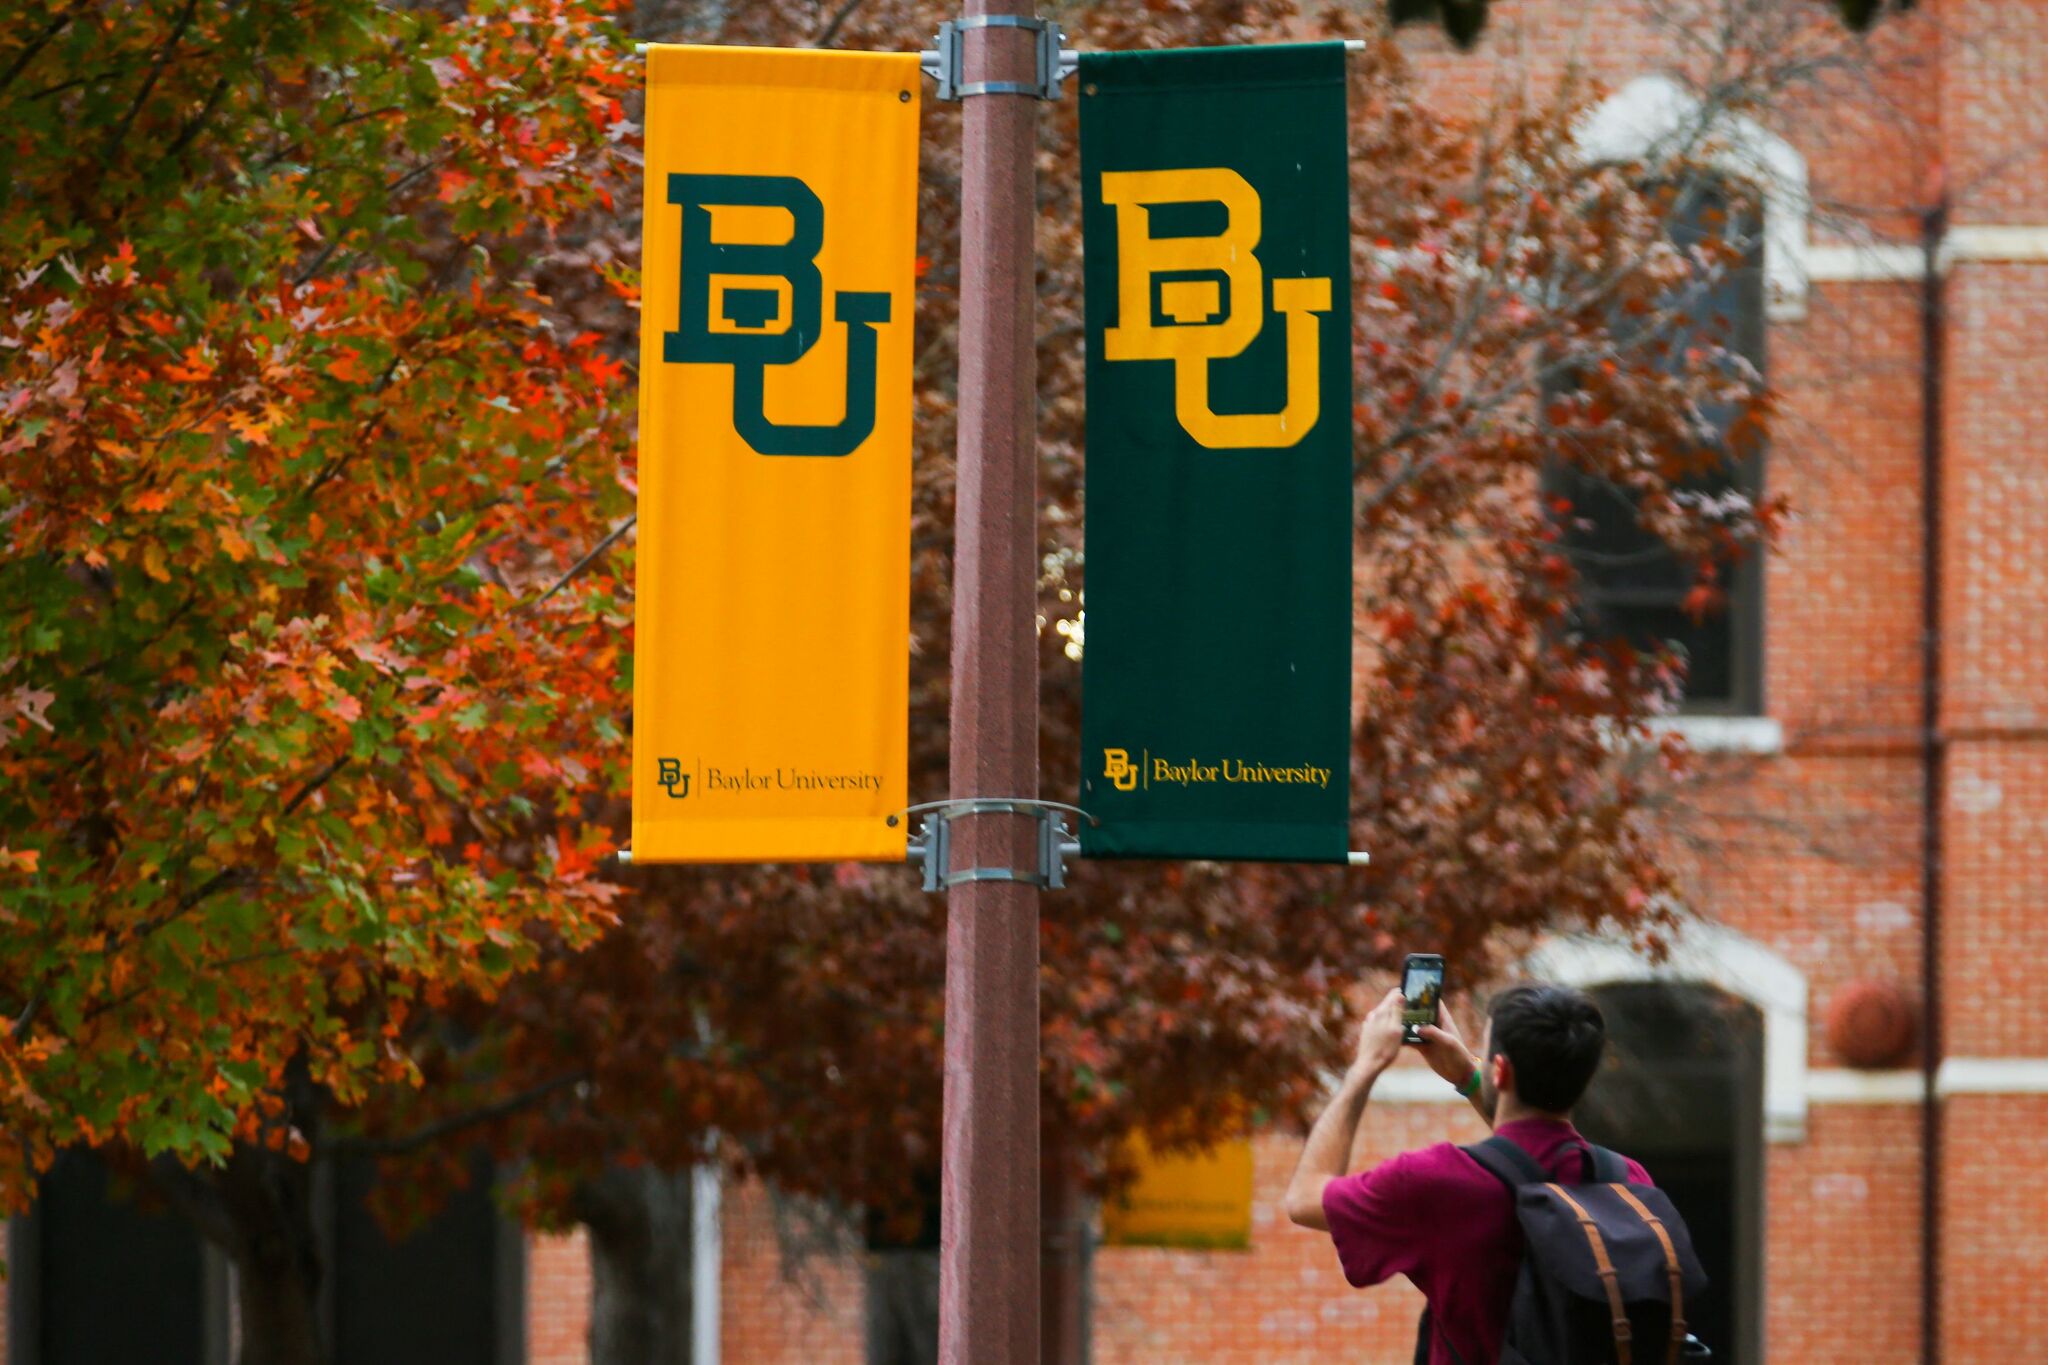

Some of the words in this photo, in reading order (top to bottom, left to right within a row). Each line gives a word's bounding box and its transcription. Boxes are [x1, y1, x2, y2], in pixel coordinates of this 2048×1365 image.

[663, 172, 892, 457] BU
[1100, 167, 1332, 449] BU
[657, 758, 690, 798] BU
[708, 768, 771, 793] Baylor
[777, 768, 883, 793] University
[1104, 748, 1138, 790] BU
[1153, 758, 1219, 787] Baylor
[1222, 759, 1331, 789] University
